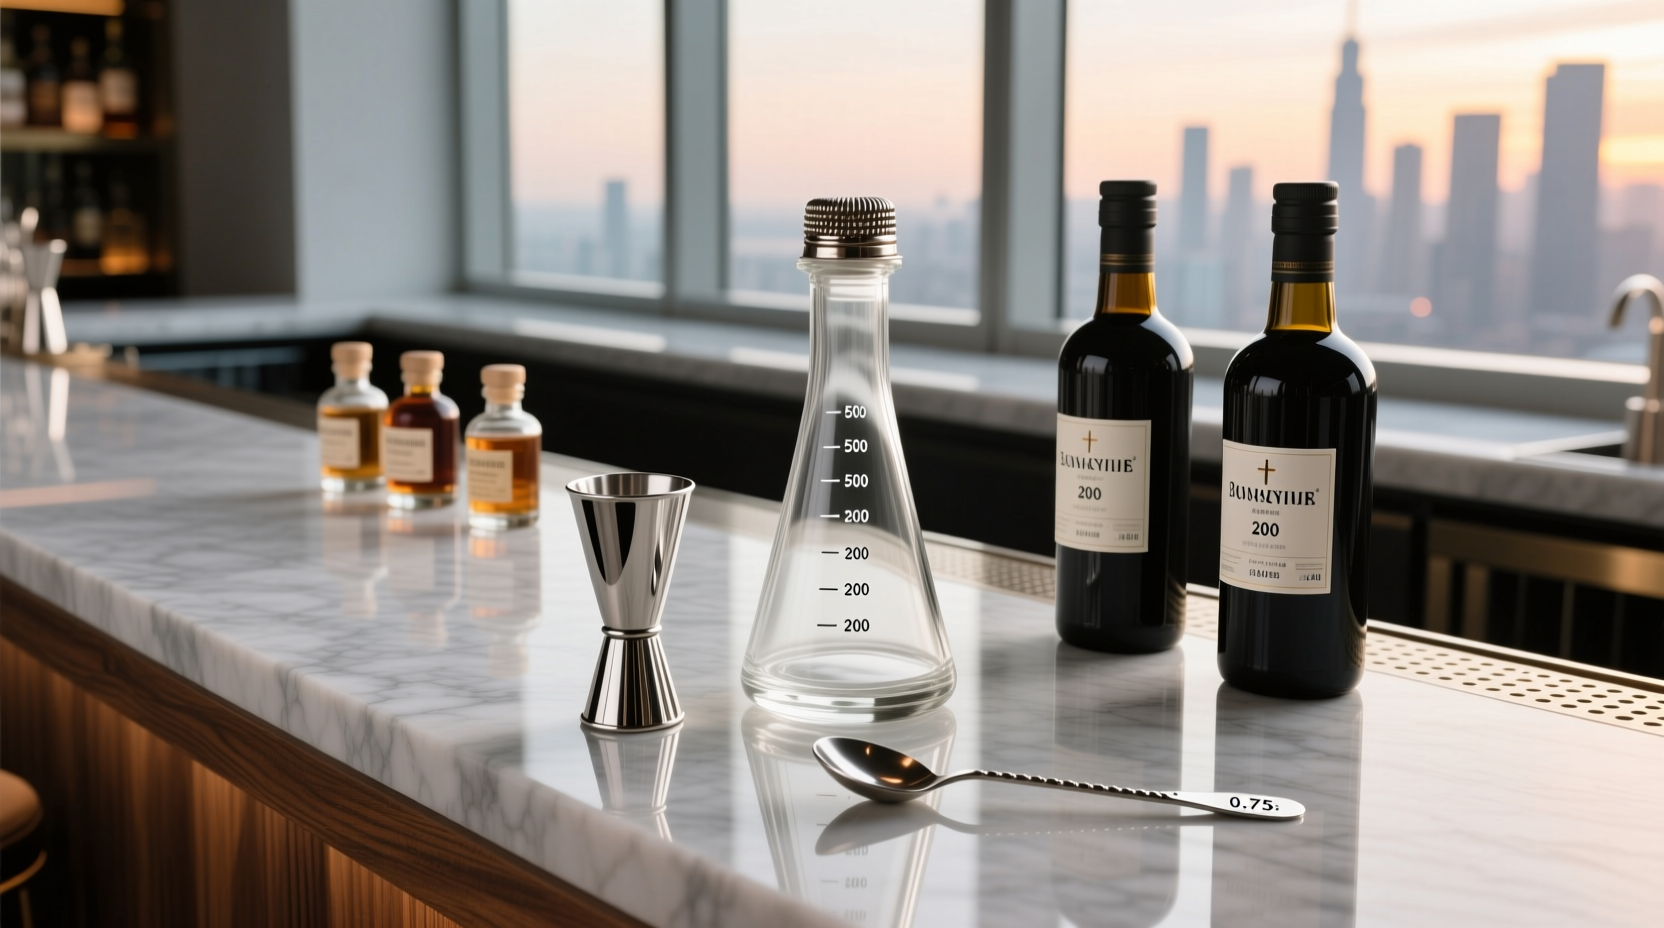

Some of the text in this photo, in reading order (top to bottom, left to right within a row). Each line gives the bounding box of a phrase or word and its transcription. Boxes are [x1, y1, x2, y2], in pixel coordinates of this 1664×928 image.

[844, 405, 867, 419] 500
[844, 439, 868, 453] 500
[844, 474, 869, 488] 500
[1078, 485, 1102, 501] 200
[844, 509, 869, 523] 200
[1251, 521, 1280, 537] 200
[844, 547, 869, 560] 200
[844, 583, 870, 596] 200
[844, 619, 870, 632] 200
